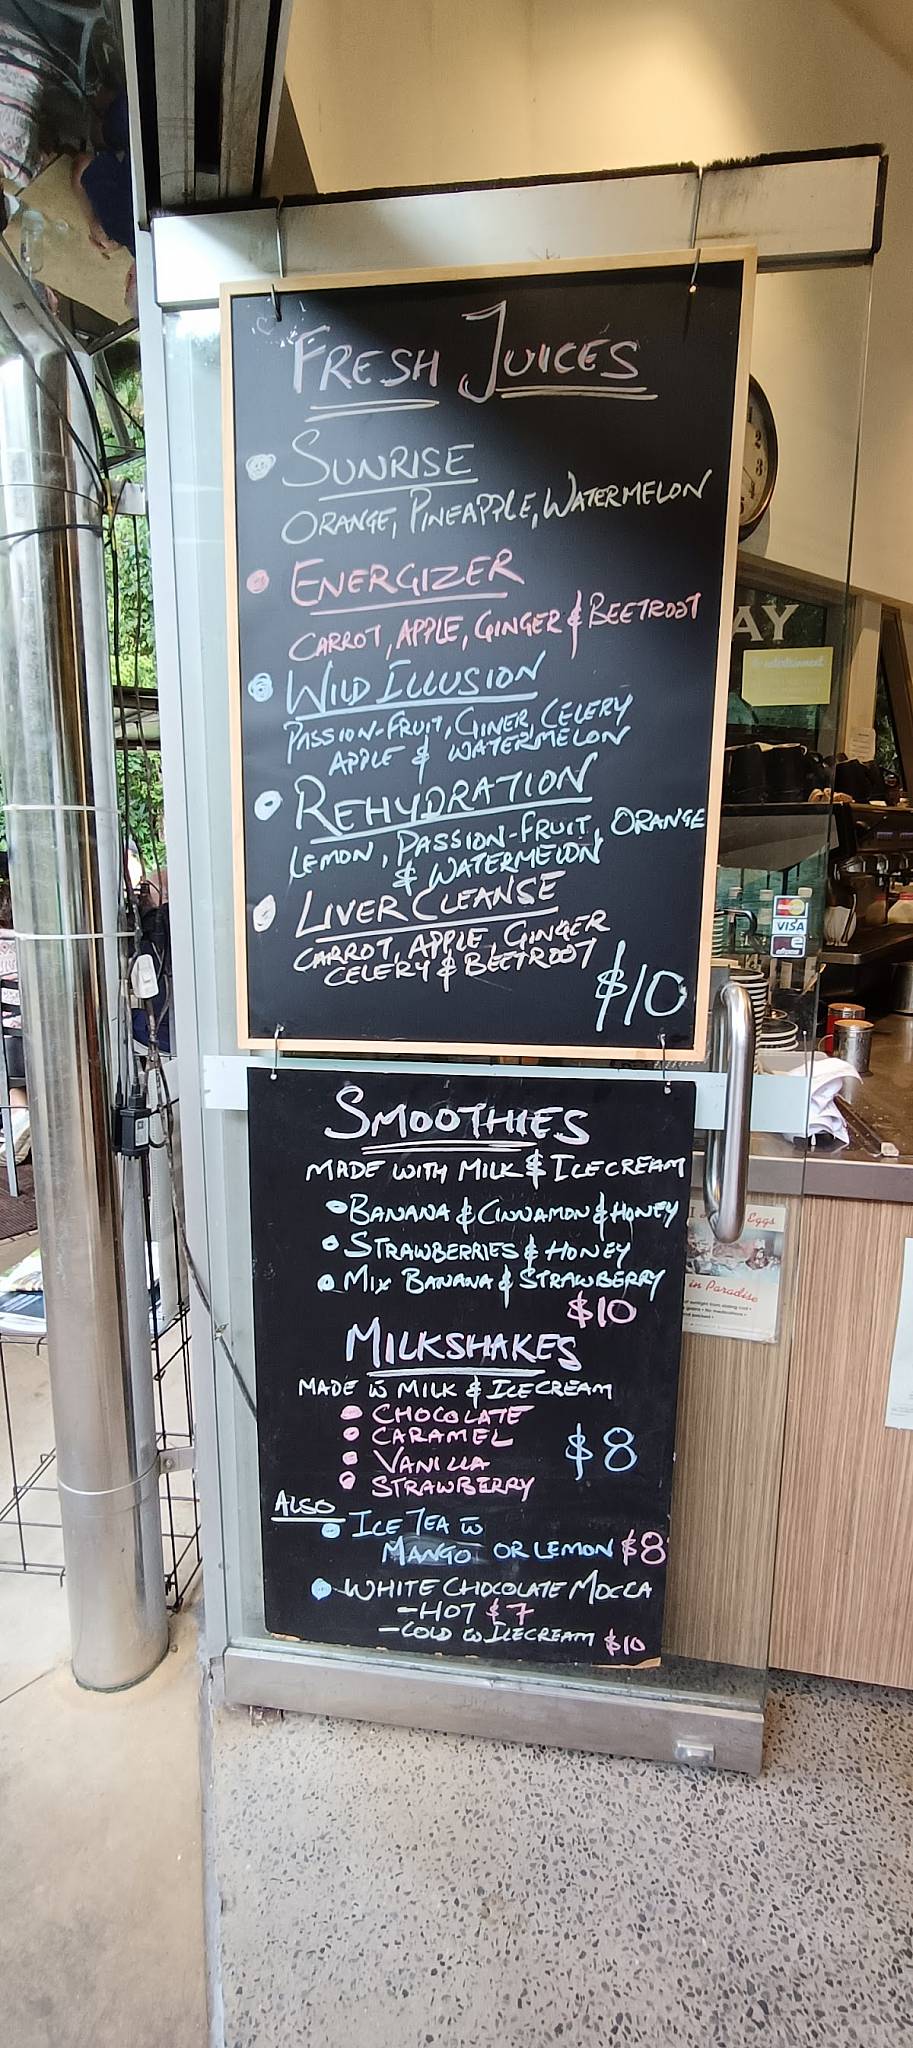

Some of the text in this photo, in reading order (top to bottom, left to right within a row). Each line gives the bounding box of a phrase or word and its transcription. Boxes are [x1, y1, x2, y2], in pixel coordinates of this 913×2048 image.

[292, 301, 640, 403] FRESH JUICES
[282, 429, 475, 487] SUNRISE
[281, 507, 397, 544] ORANGE,
[543, 470, 713, 519] WATERMELON
[290, 549, 525, 606] ENERGIZER
[474, 608, 563, 643] GINGER
[567, 591, 583, 659] &
[589, 593, 701, 628] BEETROOT
[285, 651, 546, 716] WILD ILLUSION
[541, 695, 633, 731] CELERY
[329, 725, 632, 783] APPLE & WATERMELON
[295, 752, 598, 834] REHYDRATION
[611, 807, 705, 835] ORANGE
[392, 836, 603, 896] & WATERMELON
[295, 870, 565, 938] LIVER CLEANSE
[503, 910, 611, 949] GINGER
[777, 922, 805, 931] VISA
[324, 938, 598, 992] CELERY & BEETROOT
[594, 940, 687, 1032] $10
[324, 1085, 590, 1144] SMOOTHIES
[305, 1159, 380, 1183] MADE
[391, 1162, 448, 1184] WITH
[458, 1159, 524, 1182] MILK
[526, 1149, 546, 1189] &
[349, 1193, 450, 1225] BANANA
[456, 1197, 473, 1234] &
[478, 1200, 589, 1224] CINNAMON
[593, 1192, 608, 1241] &
[610, 1201, 680, 1234] HONEY
[747, 1212, 776, 1227] Eggs
[343, 1231, 632, 1270] STRAWBERRIES & HONEY
[343, 1264, 667, 1308] MIX BANANA & STRAWBERRY
[689, 1280, 759, 1303] in Paradise
[566, 1290, 637, 1329] $10
[345, 1316, 582, 1372] MILKSHAKES
[298, 1378, 356, 1398] MADE
[397, 1381, 457, 1398] MILK
[466, 1374, 483, 1409] &
[371, 1405, 534, 1424] CHOCOLATE
[371, 1427, 513, 1447] CARAMEL
[373, 1449, 490, 1474] VANILLA
[273, 1489, 336, 1515] ALSO
[371, 1475, 536, 1501] STRAWBERRY
[348, 1510, 401, 1537] ICE
[411, 1508, 449, 1536] TEA
[382, 1529, 666, 1567] MANGO OR LEMON $8
[343, 1570, 653, 1603] WHITE CHOCOLATE MOCCA
[603, 1628, 646, 1655] $10
